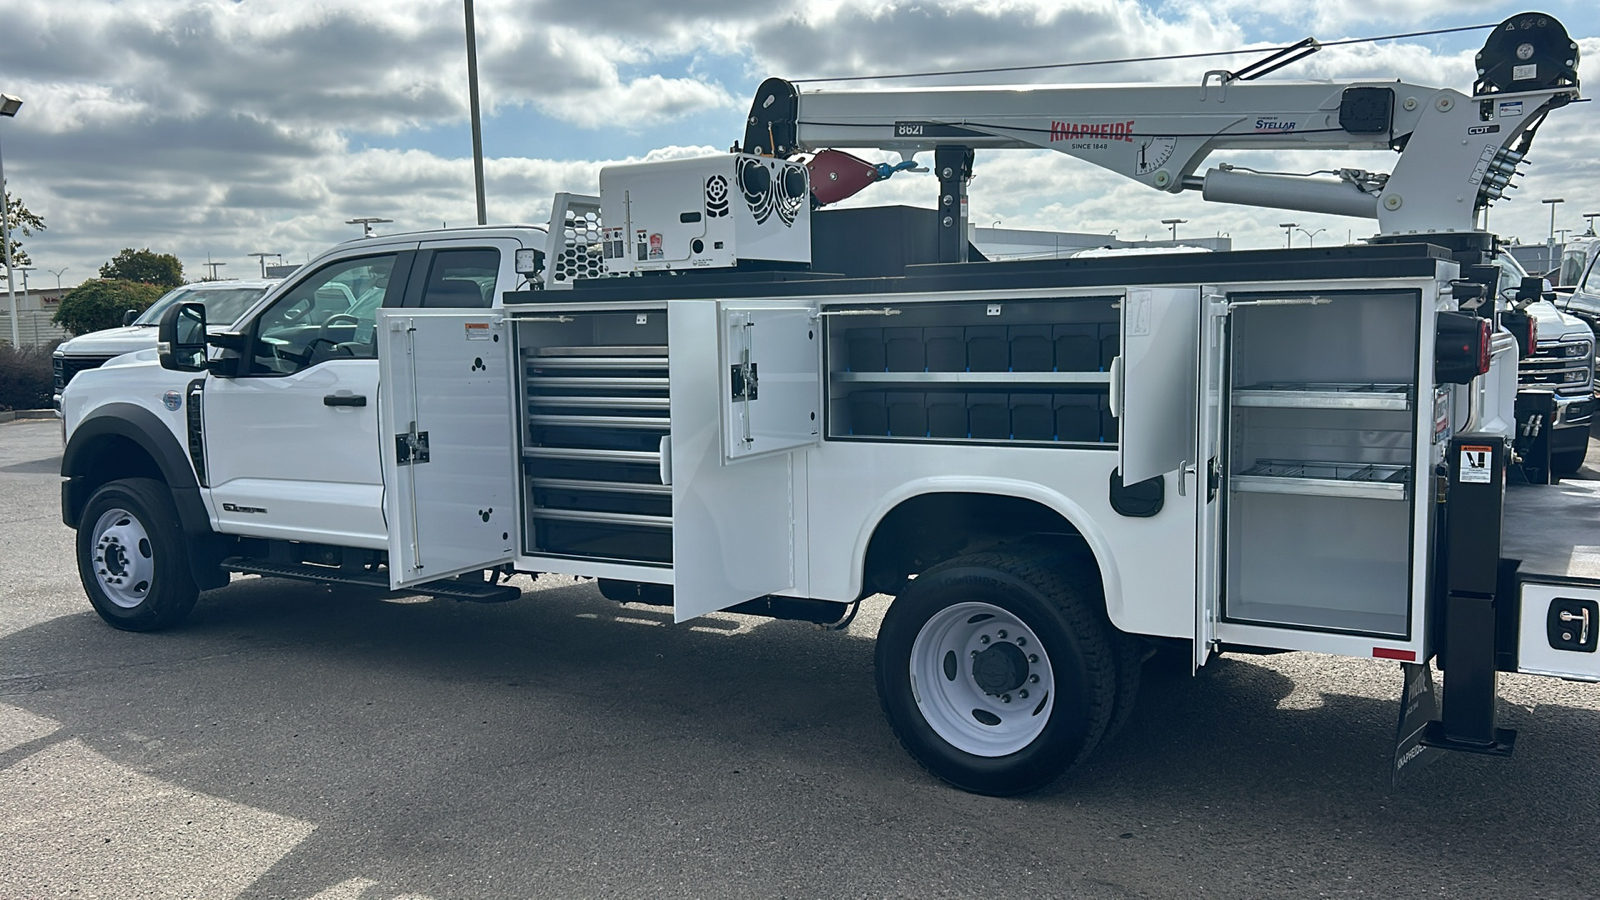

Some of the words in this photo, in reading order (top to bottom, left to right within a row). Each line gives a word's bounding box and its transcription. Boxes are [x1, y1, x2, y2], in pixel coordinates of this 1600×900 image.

[898, 122, 924, 135] 8621
[1255, 119, 1296, 130] STELLAR
[1469, 126, 1490, 135] CDT
[1049, 120, 1135, 143] KNAPHEIDE
